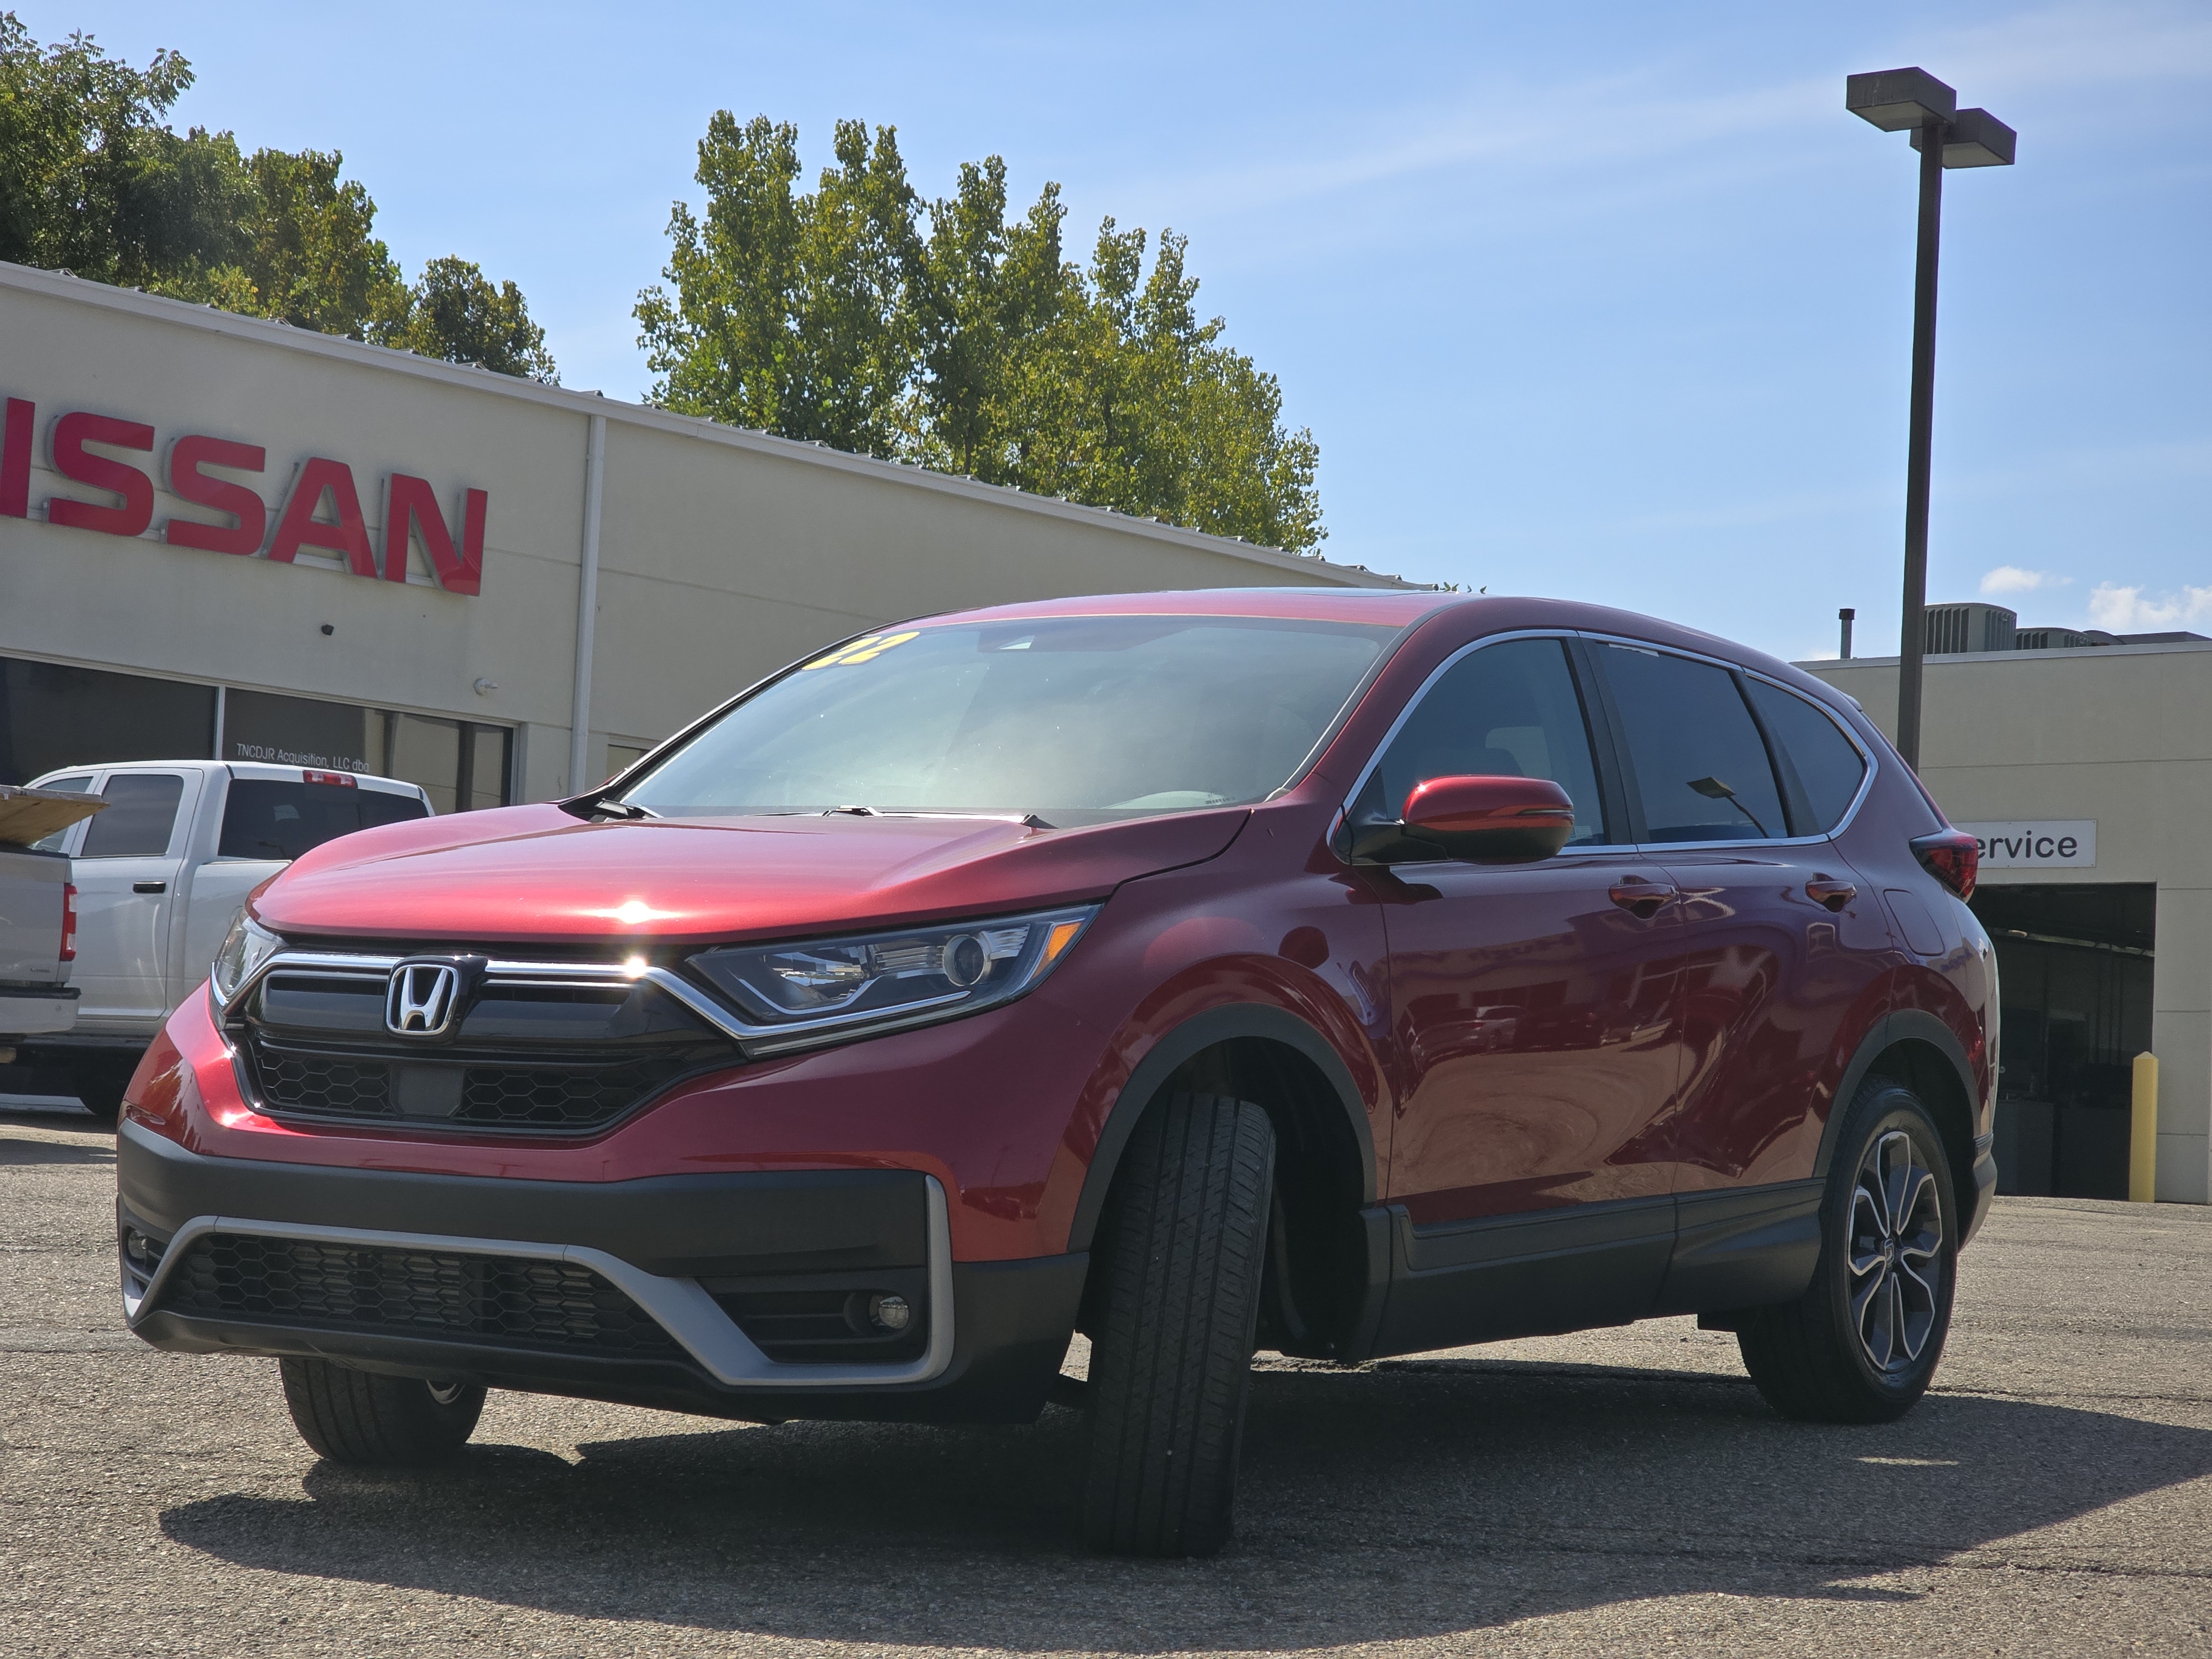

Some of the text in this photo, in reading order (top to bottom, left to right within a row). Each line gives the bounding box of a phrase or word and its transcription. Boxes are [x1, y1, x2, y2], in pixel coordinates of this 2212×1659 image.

[237, 743, 369, 773] TNCDJR Acquisition, LLC dba
